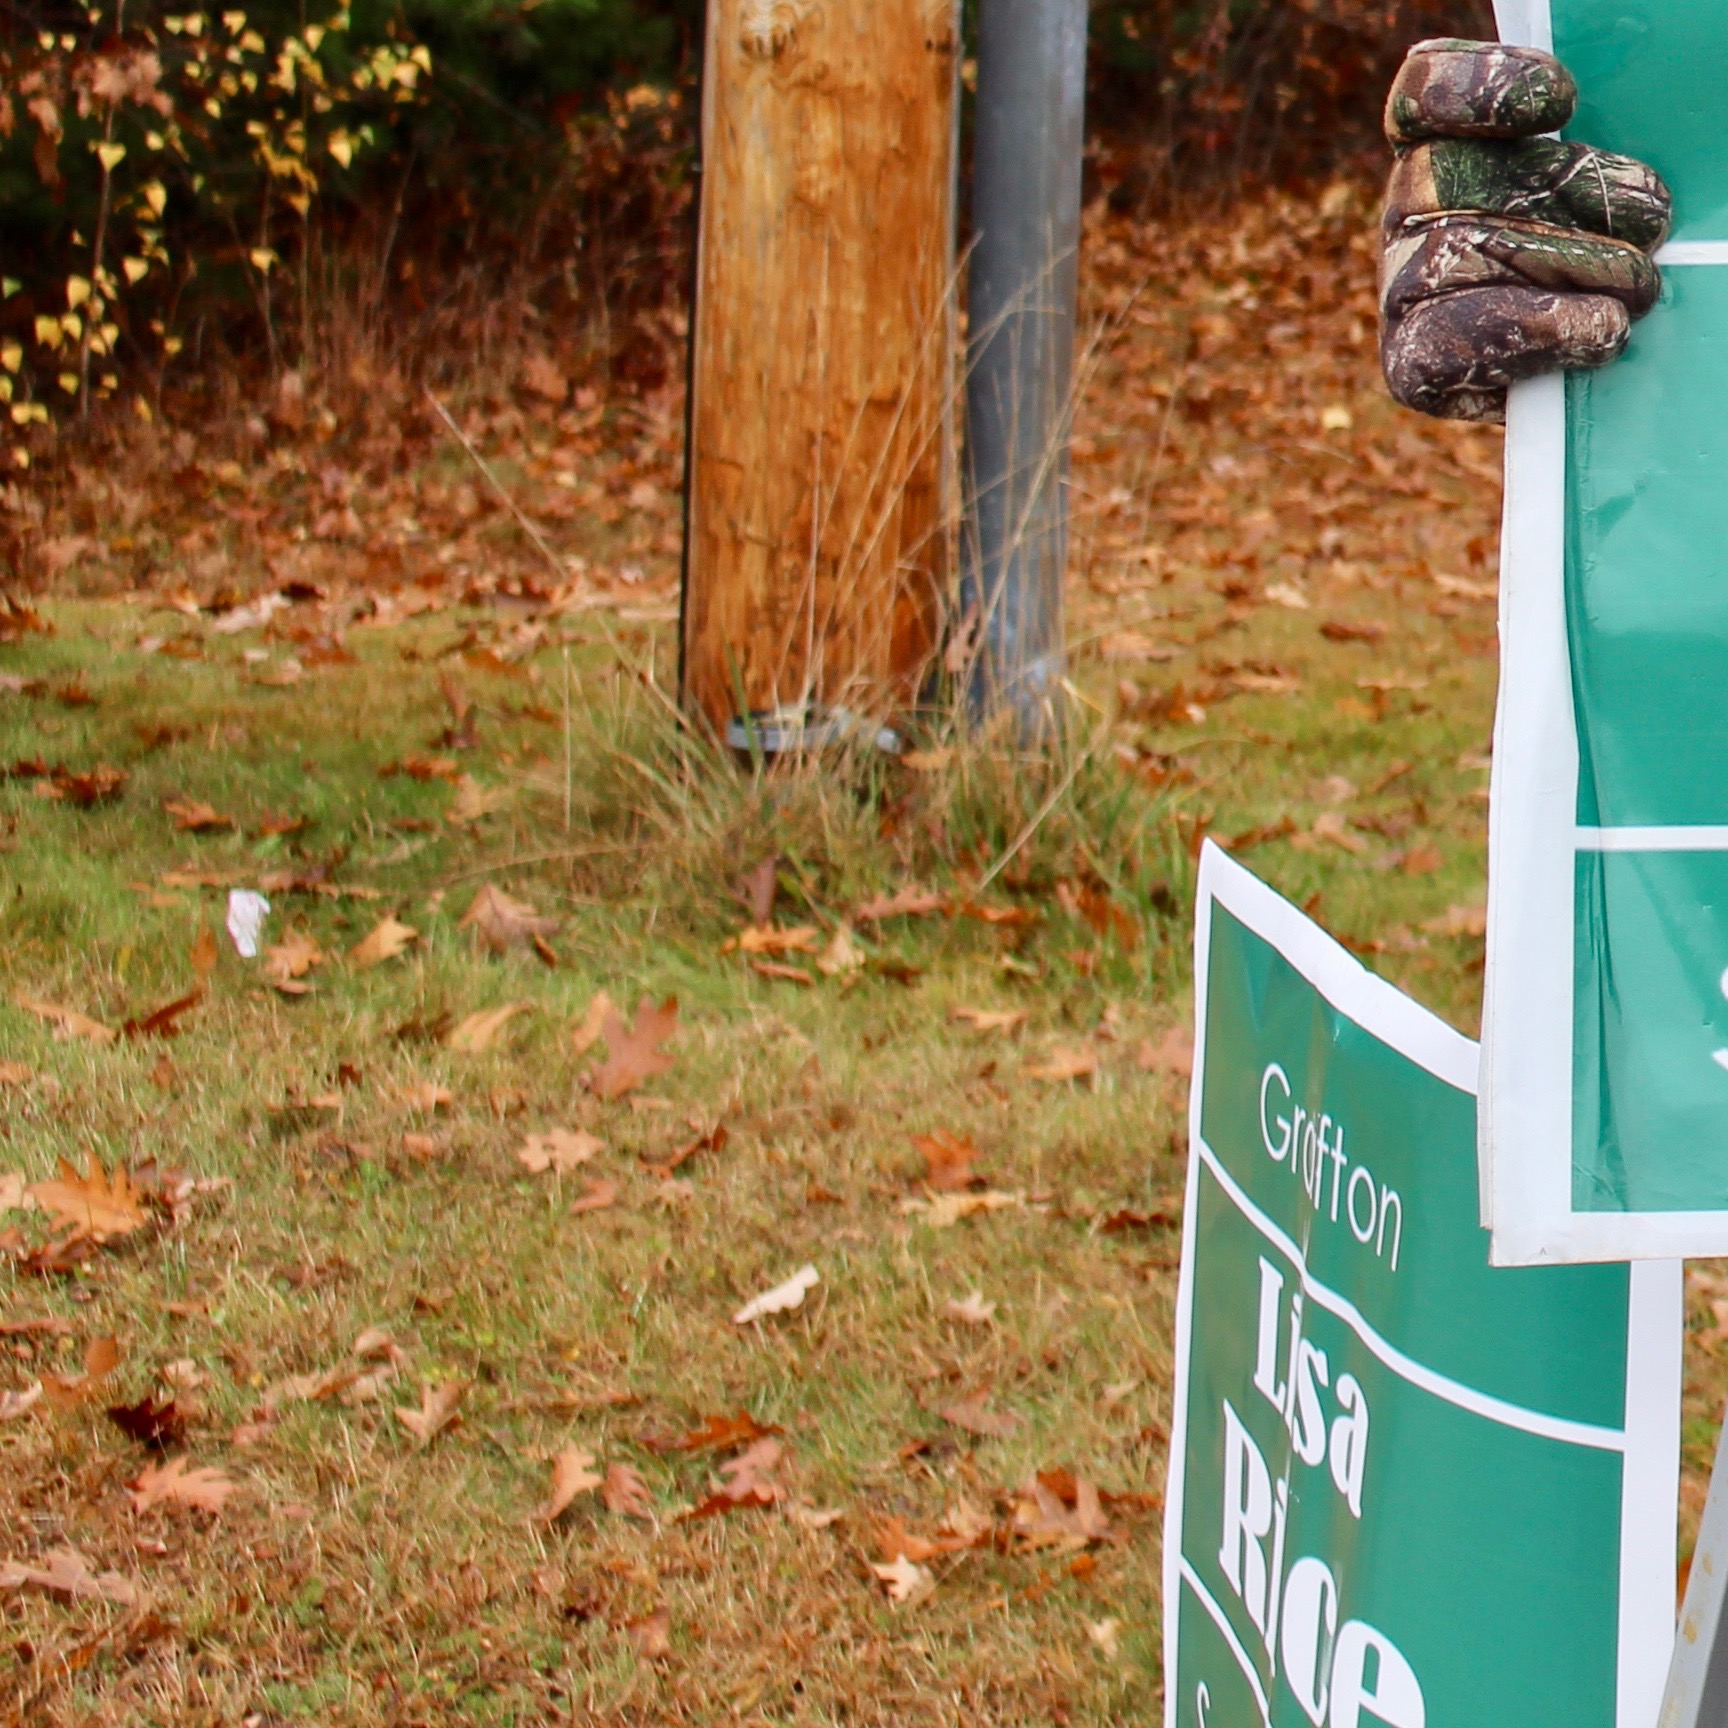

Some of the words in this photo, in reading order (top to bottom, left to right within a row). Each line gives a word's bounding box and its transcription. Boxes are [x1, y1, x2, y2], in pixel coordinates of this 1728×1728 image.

[1259, 1062, 1402, 1272] Grafton
[1254, 1256, 1369, 1519] Lisa
[1219, 1399, 1426, 1728] Rice
